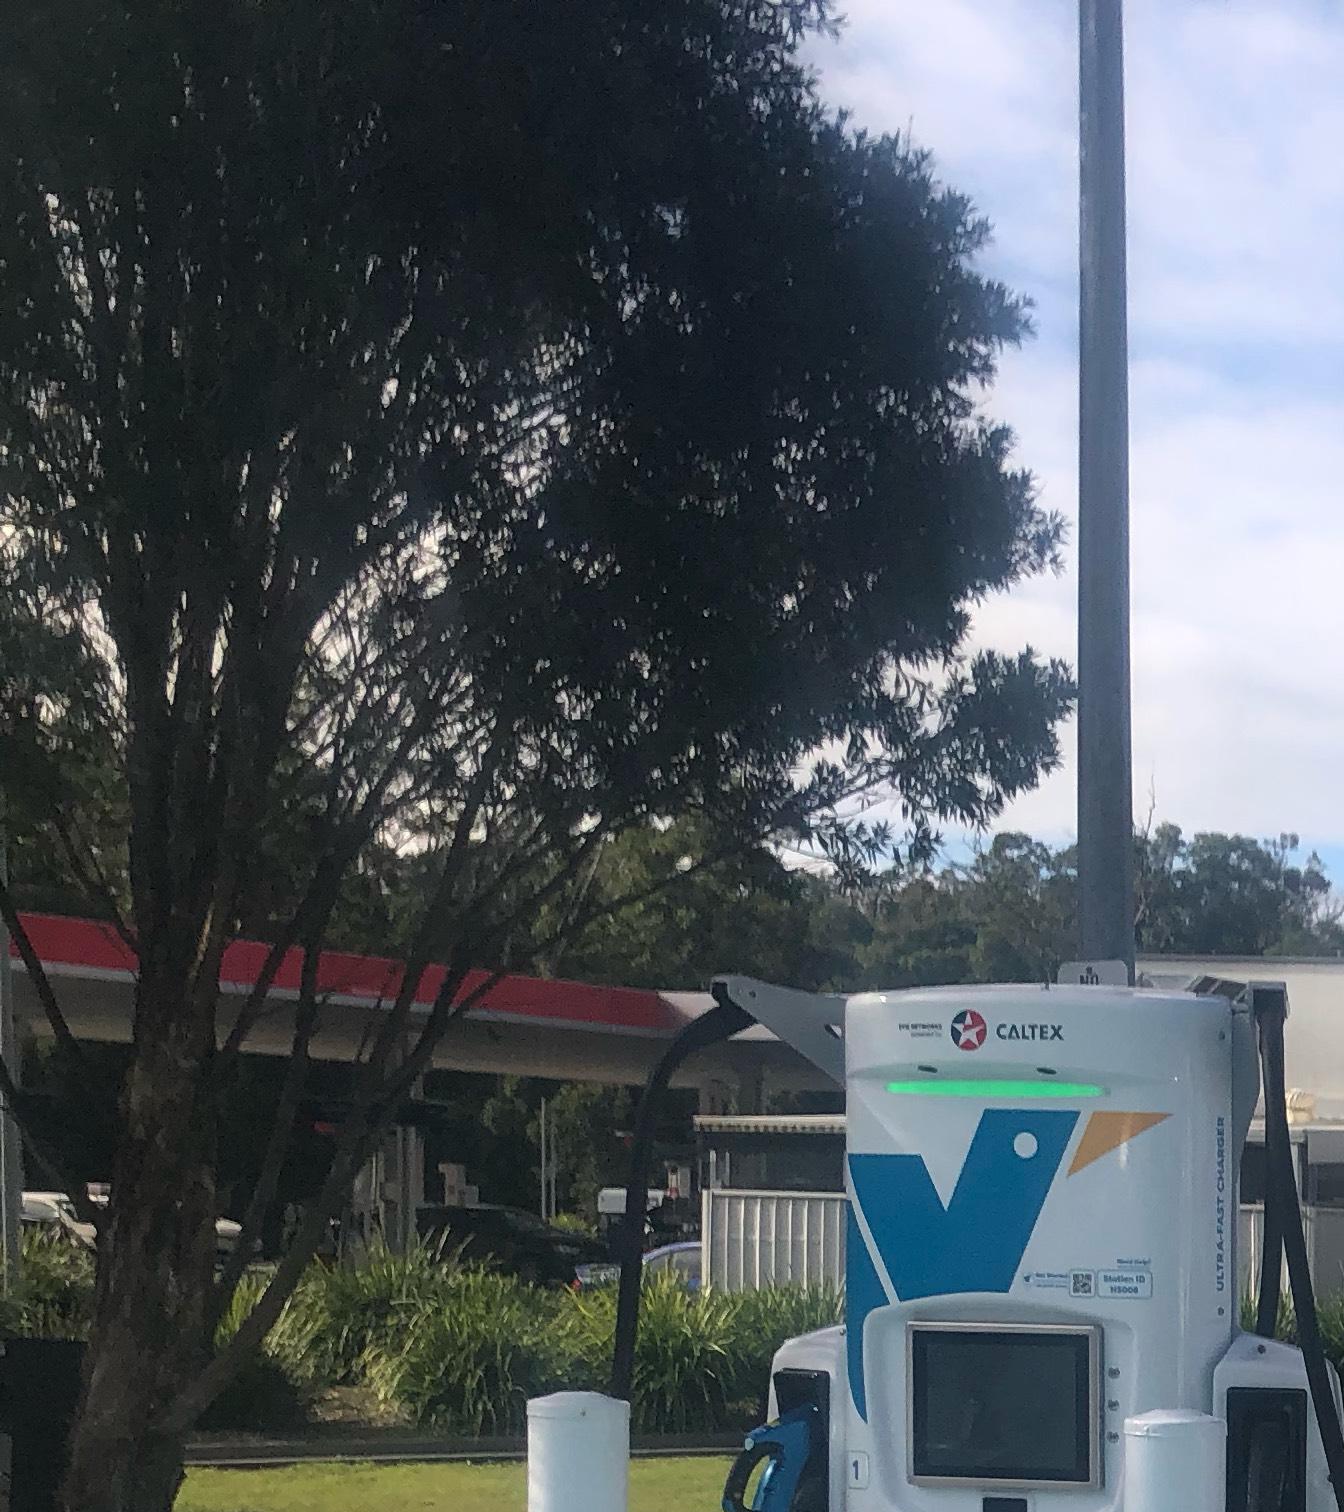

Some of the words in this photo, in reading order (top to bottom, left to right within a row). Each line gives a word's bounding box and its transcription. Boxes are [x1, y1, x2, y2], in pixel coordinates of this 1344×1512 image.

[996, 1023, 1065, 1041] CALTEX
[1216, 1116, 1225, 1192] CHARGER
[1216, 1197, 1225, 1292] ULTRA-FAST
[1136, 1275, 1146, 1283] ID
[852, 1459, 859, 1480] 1
